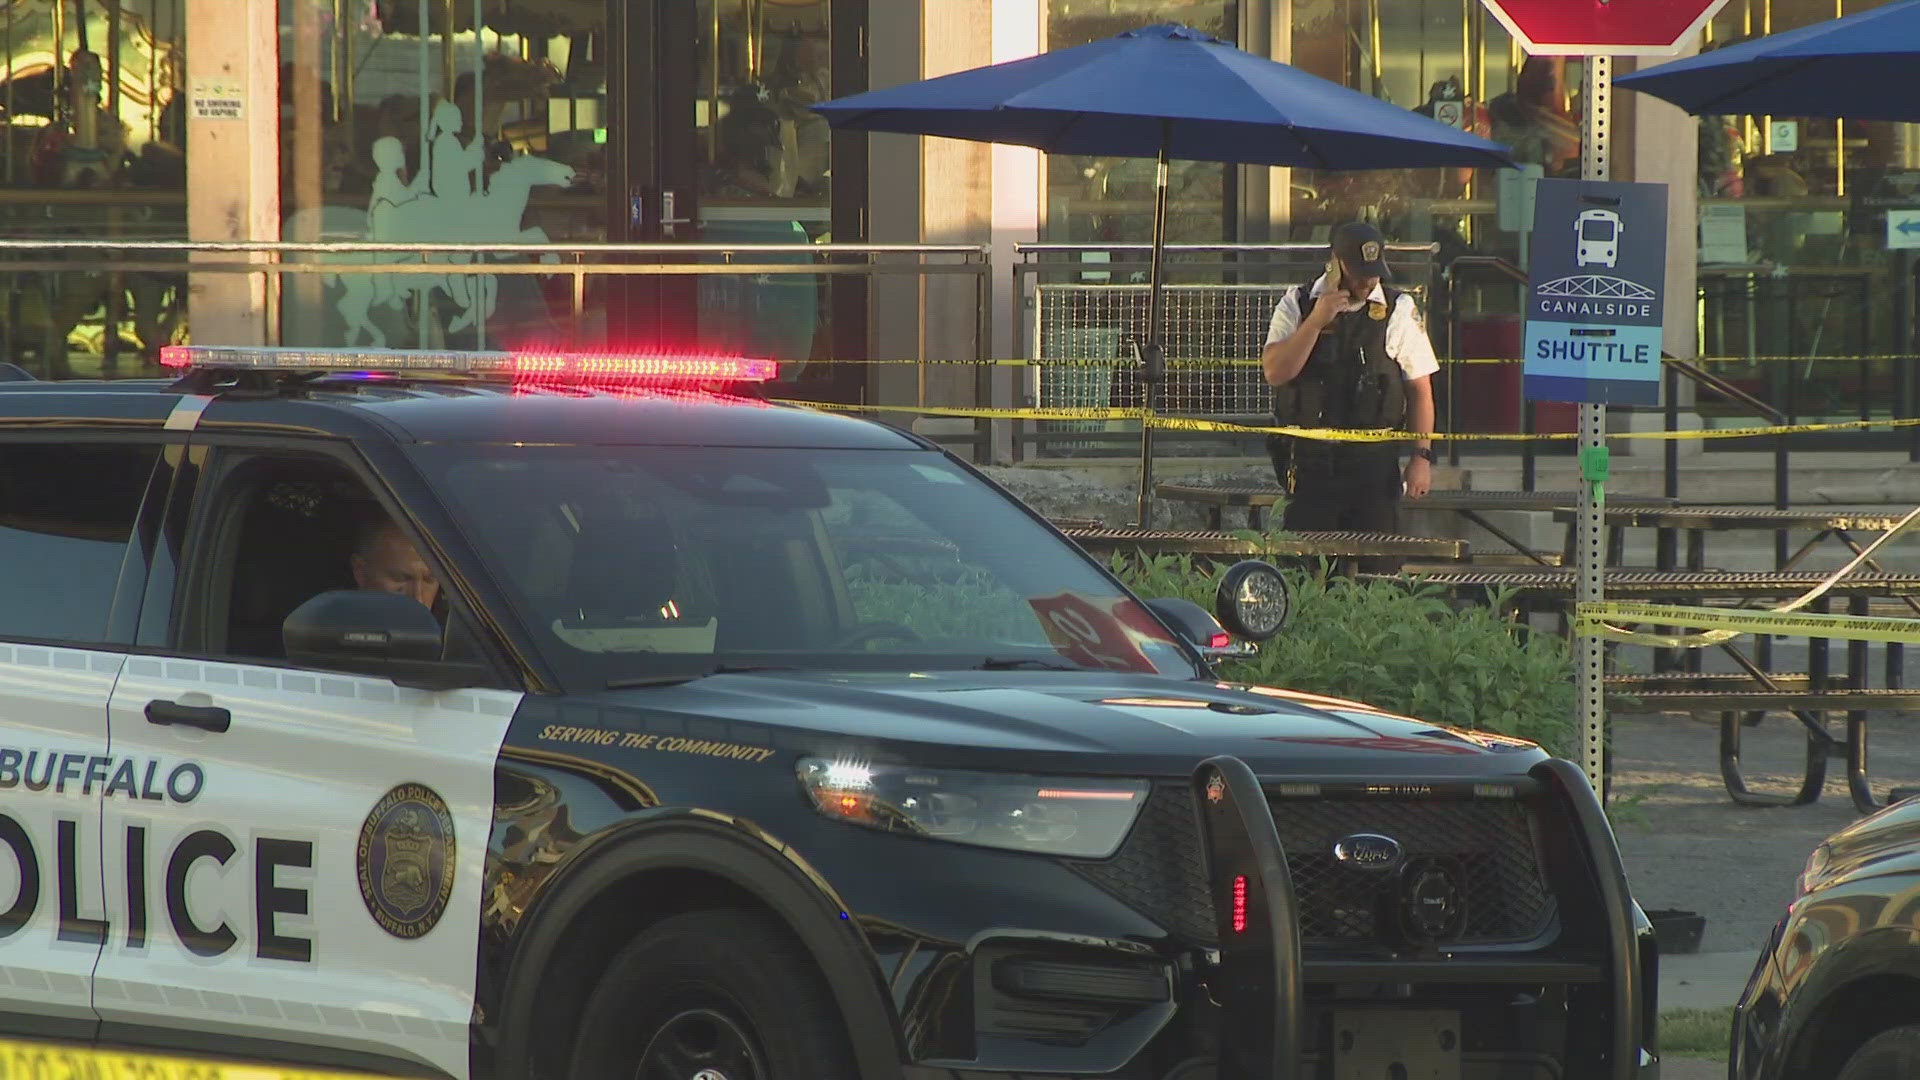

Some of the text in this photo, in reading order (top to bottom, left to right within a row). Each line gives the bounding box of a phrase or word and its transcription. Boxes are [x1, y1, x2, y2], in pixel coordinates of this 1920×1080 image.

[1541, 300, 1650, 316] CANALSIDE
[1537, 339, 1650, 364] SHUTTLE
[538, 725, 776, 762] SERVING THE COMMUNITY
[0, 749, 204, 804] BUFFALO
[359, 838, 369, 858] OF
[365, 788, 406, 834] BUFFALO
[408, 786, 442, 811] POLICE
[438, 810, 455, 906] DEPARTMENT
